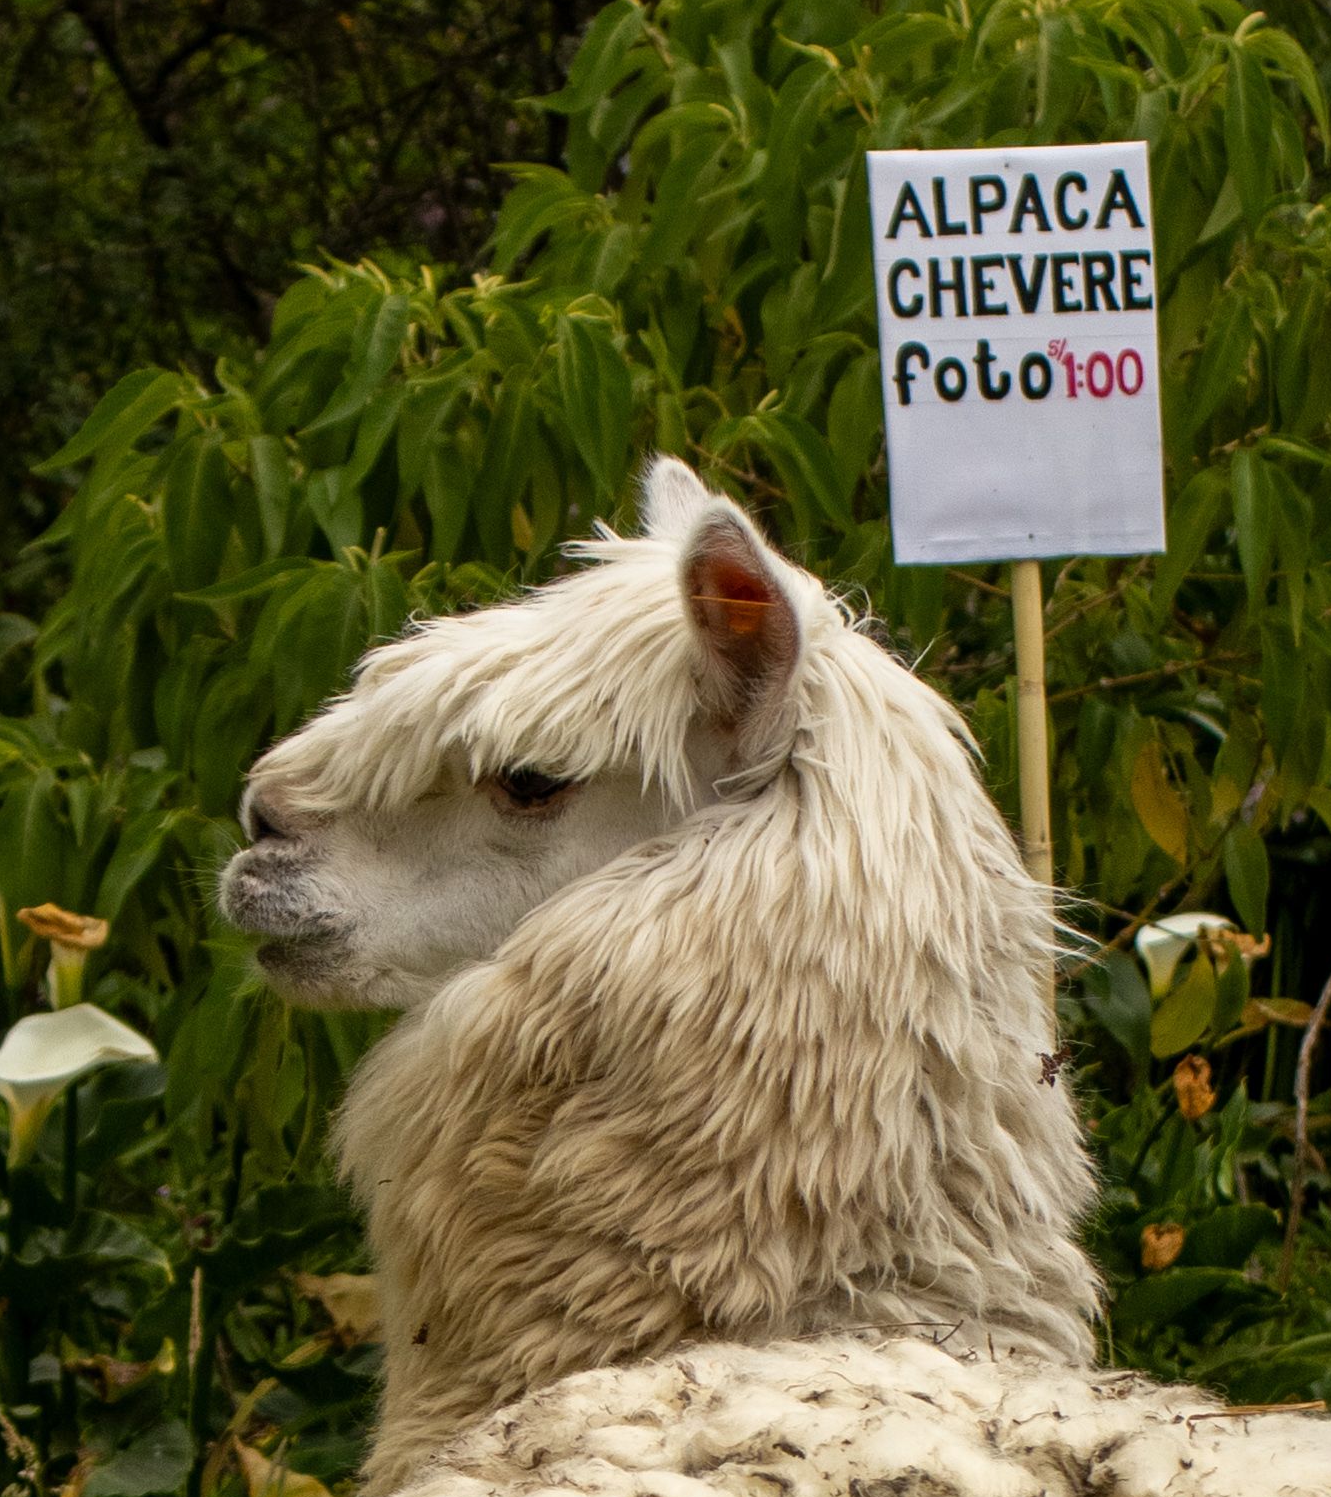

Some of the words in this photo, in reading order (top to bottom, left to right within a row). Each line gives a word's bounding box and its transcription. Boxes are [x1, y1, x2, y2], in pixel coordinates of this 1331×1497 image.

[885, 168, 1145, 239] ALPACA
[887, 249, 1153, 319] CHEVERE
[893, 338, 1053, 406] foto
